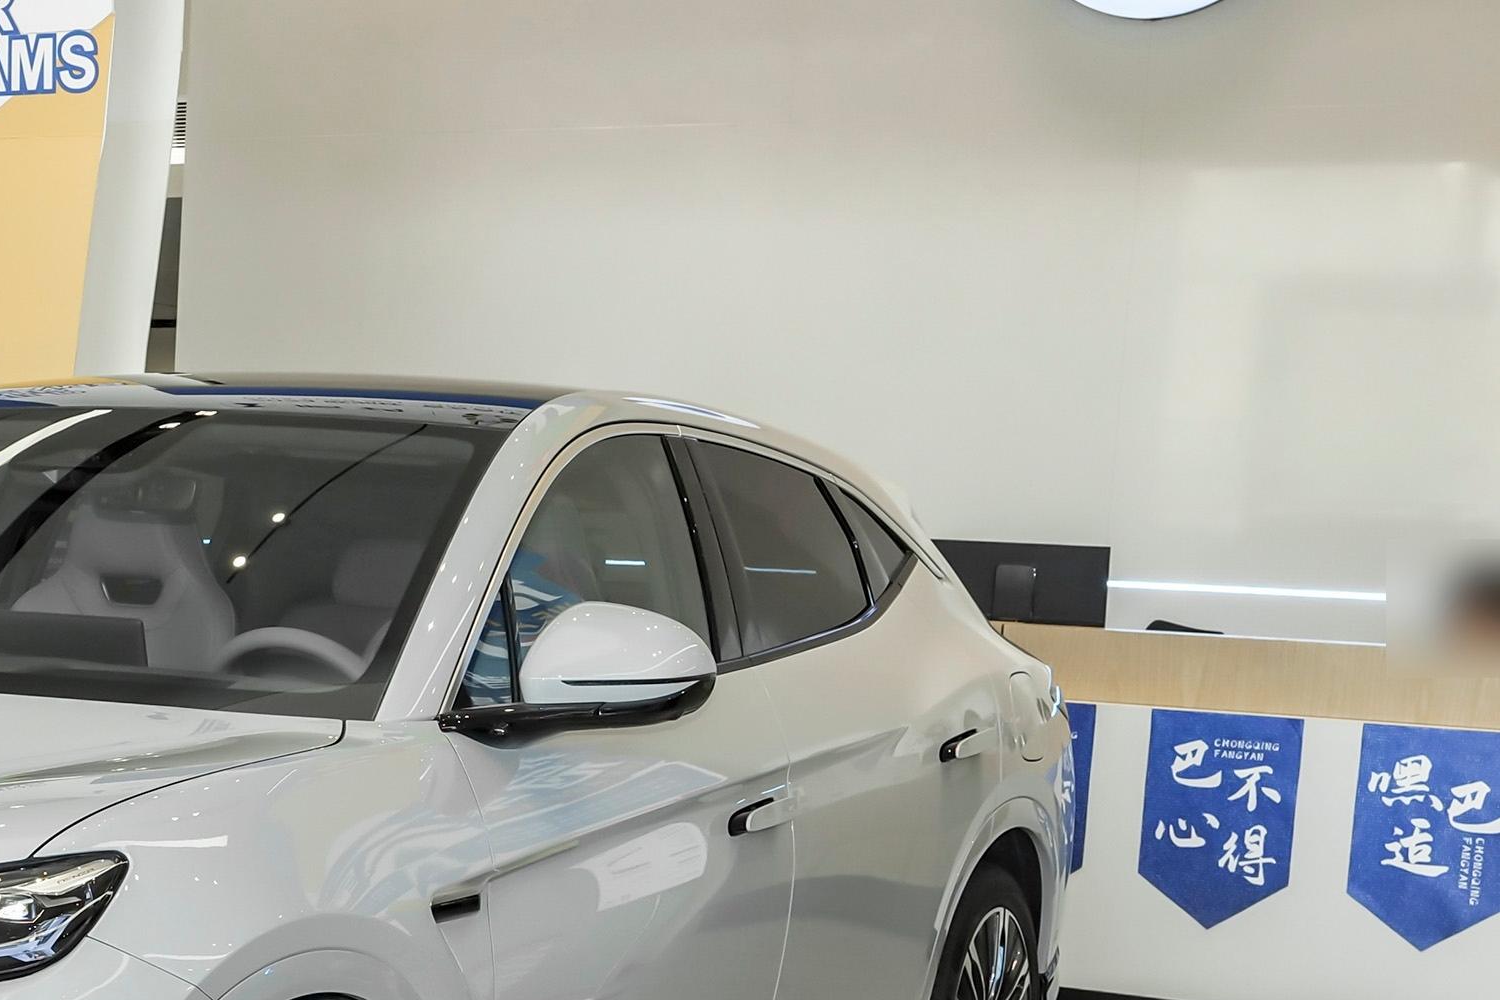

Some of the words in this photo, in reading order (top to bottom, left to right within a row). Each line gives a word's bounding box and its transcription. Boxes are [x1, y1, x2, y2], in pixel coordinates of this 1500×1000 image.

[1213, 738, 1280, 752] CHONGQING
[1213, 749, 1264, 761] FANGYAN
[1457, 837, 1473, 890] FANGYAN
[1468, 837, 1485, 906] CHONGQING
